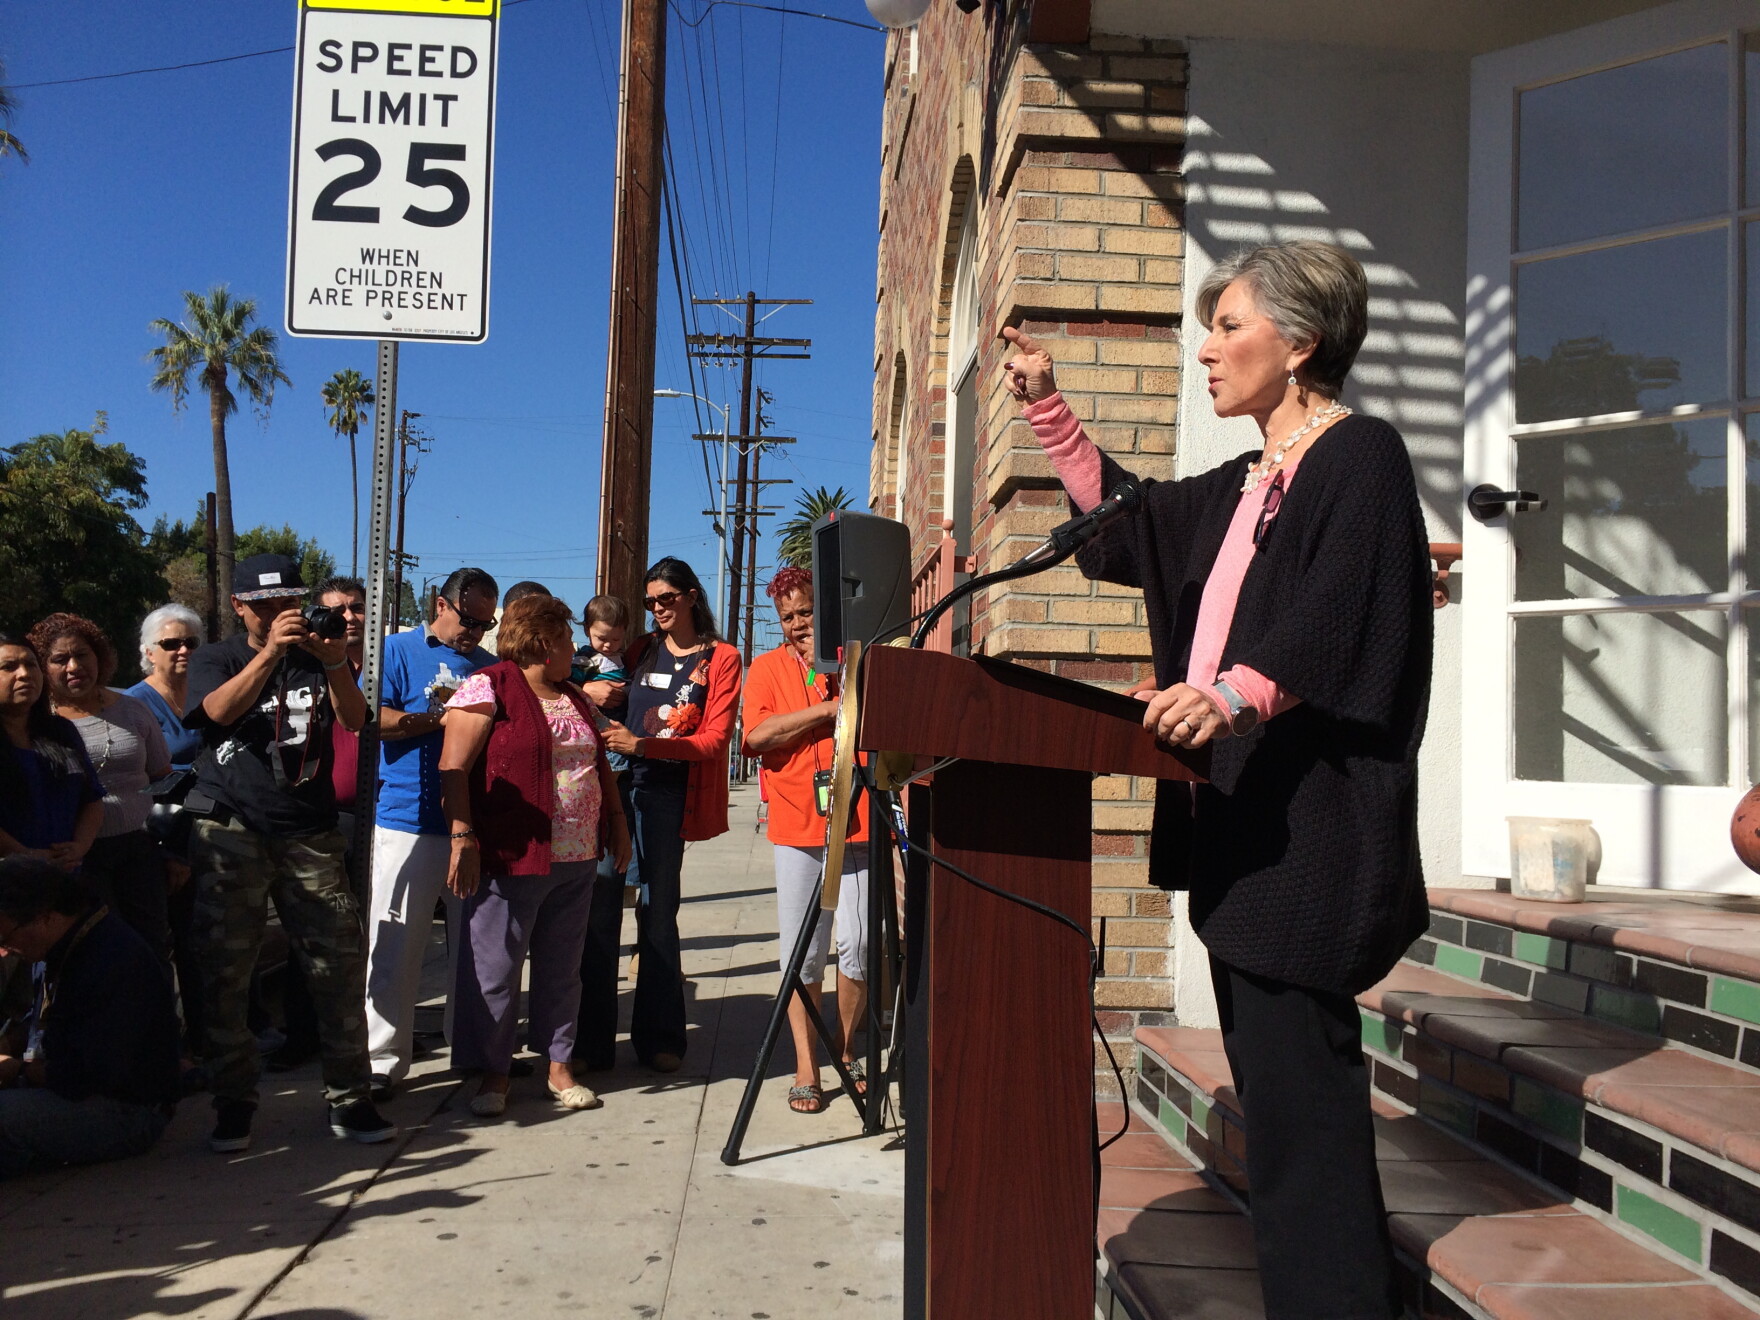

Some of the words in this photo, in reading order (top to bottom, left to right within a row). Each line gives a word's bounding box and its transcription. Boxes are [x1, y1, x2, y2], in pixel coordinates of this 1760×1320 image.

[316, 39, 478, 79] SPEED
[331, 88, 459, 128] LIMIT
[311, 137, 471, 228] 25
[360, 247, 419, 267] WHEN
[335, 267, 443, 289] CHILDREN
[308, 287, 353, 306] ARE
[365, 289, 468, 311] PRESENT
